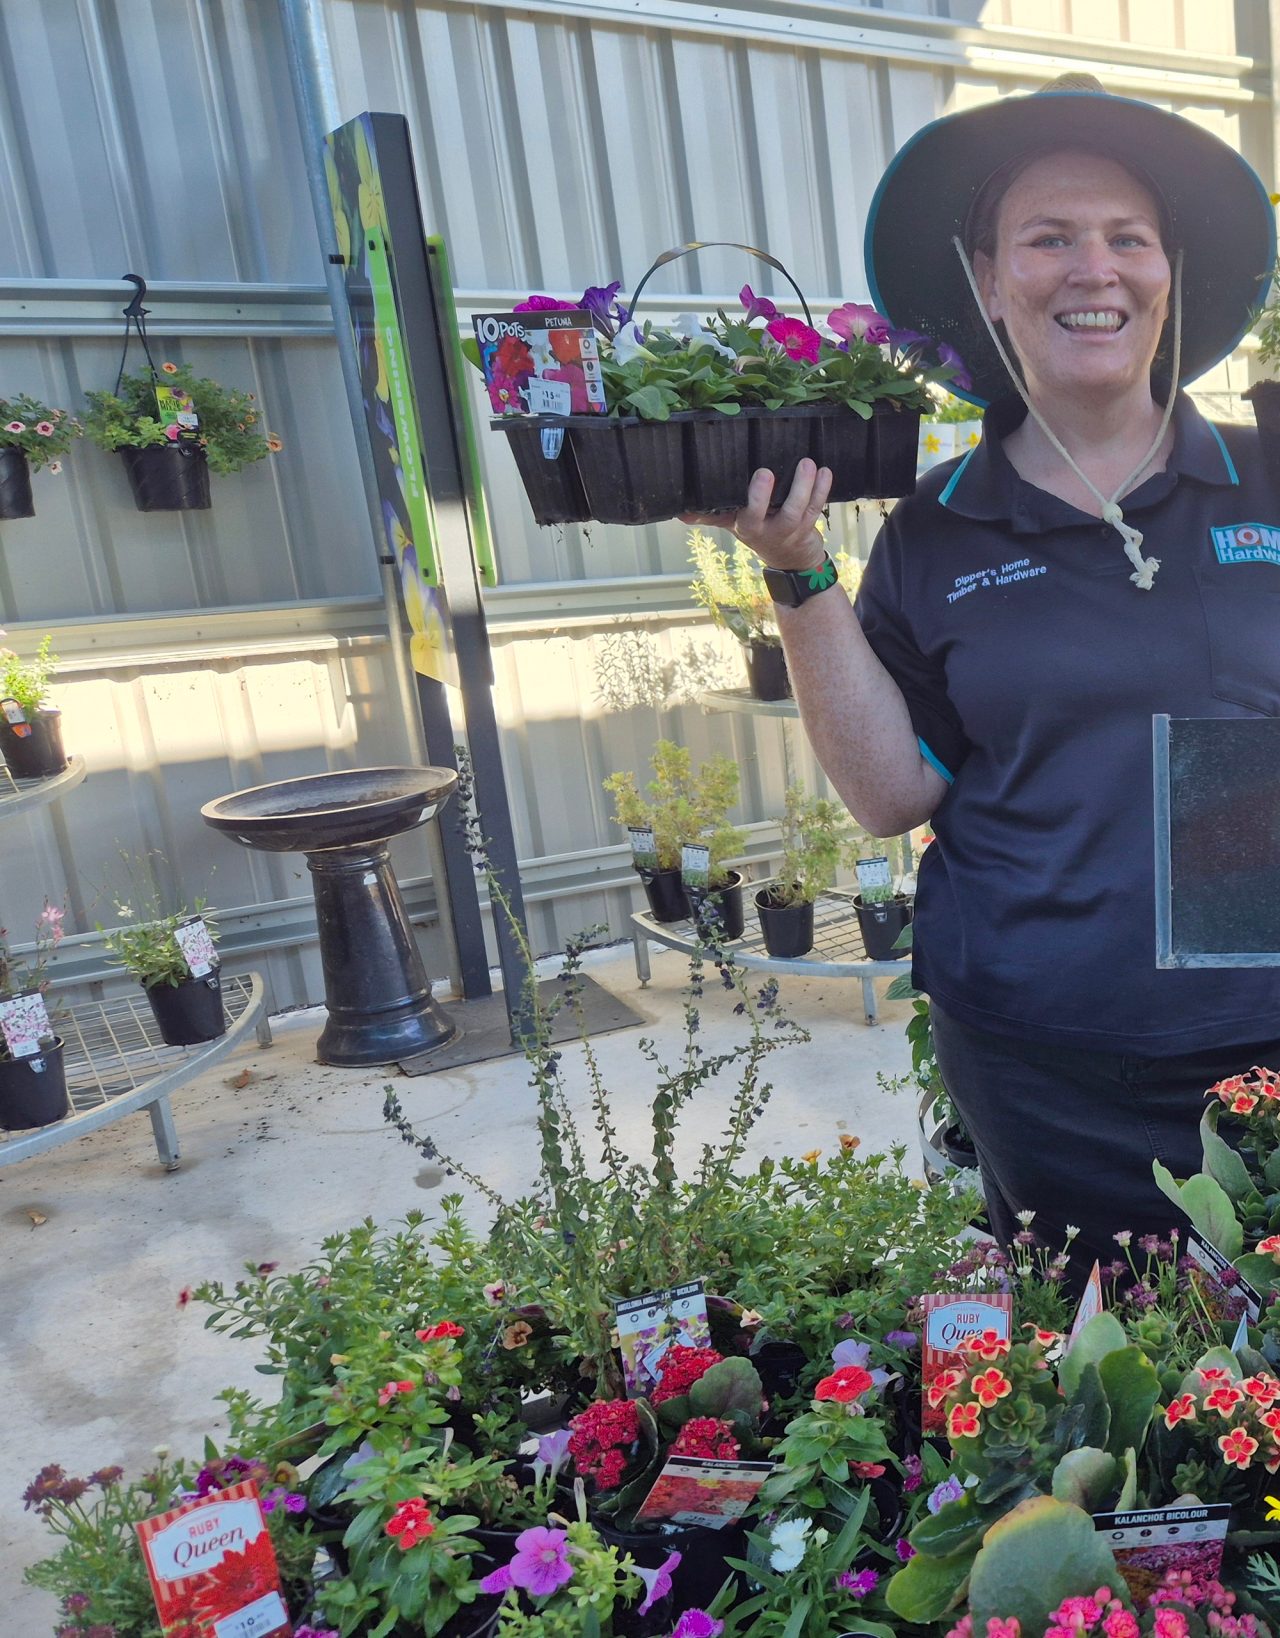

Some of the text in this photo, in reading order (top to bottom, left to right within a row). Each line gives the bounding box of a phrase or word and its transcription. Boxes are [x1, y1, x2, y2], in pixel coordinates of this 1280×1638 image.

[476, 317, 499, 344] 10
[946, 565, 1048, 604] Timber & Hardware
[954, 557, 1031, 588] Dipper's Home
[956, 1313, 980, 1324] RUBY
[188, 1517, 221, 1538] RUBY
[1114, 1508, 1208, 1526] KALANCHOE BICOLOUR
[172, 1526, 245, 1569] Queen
